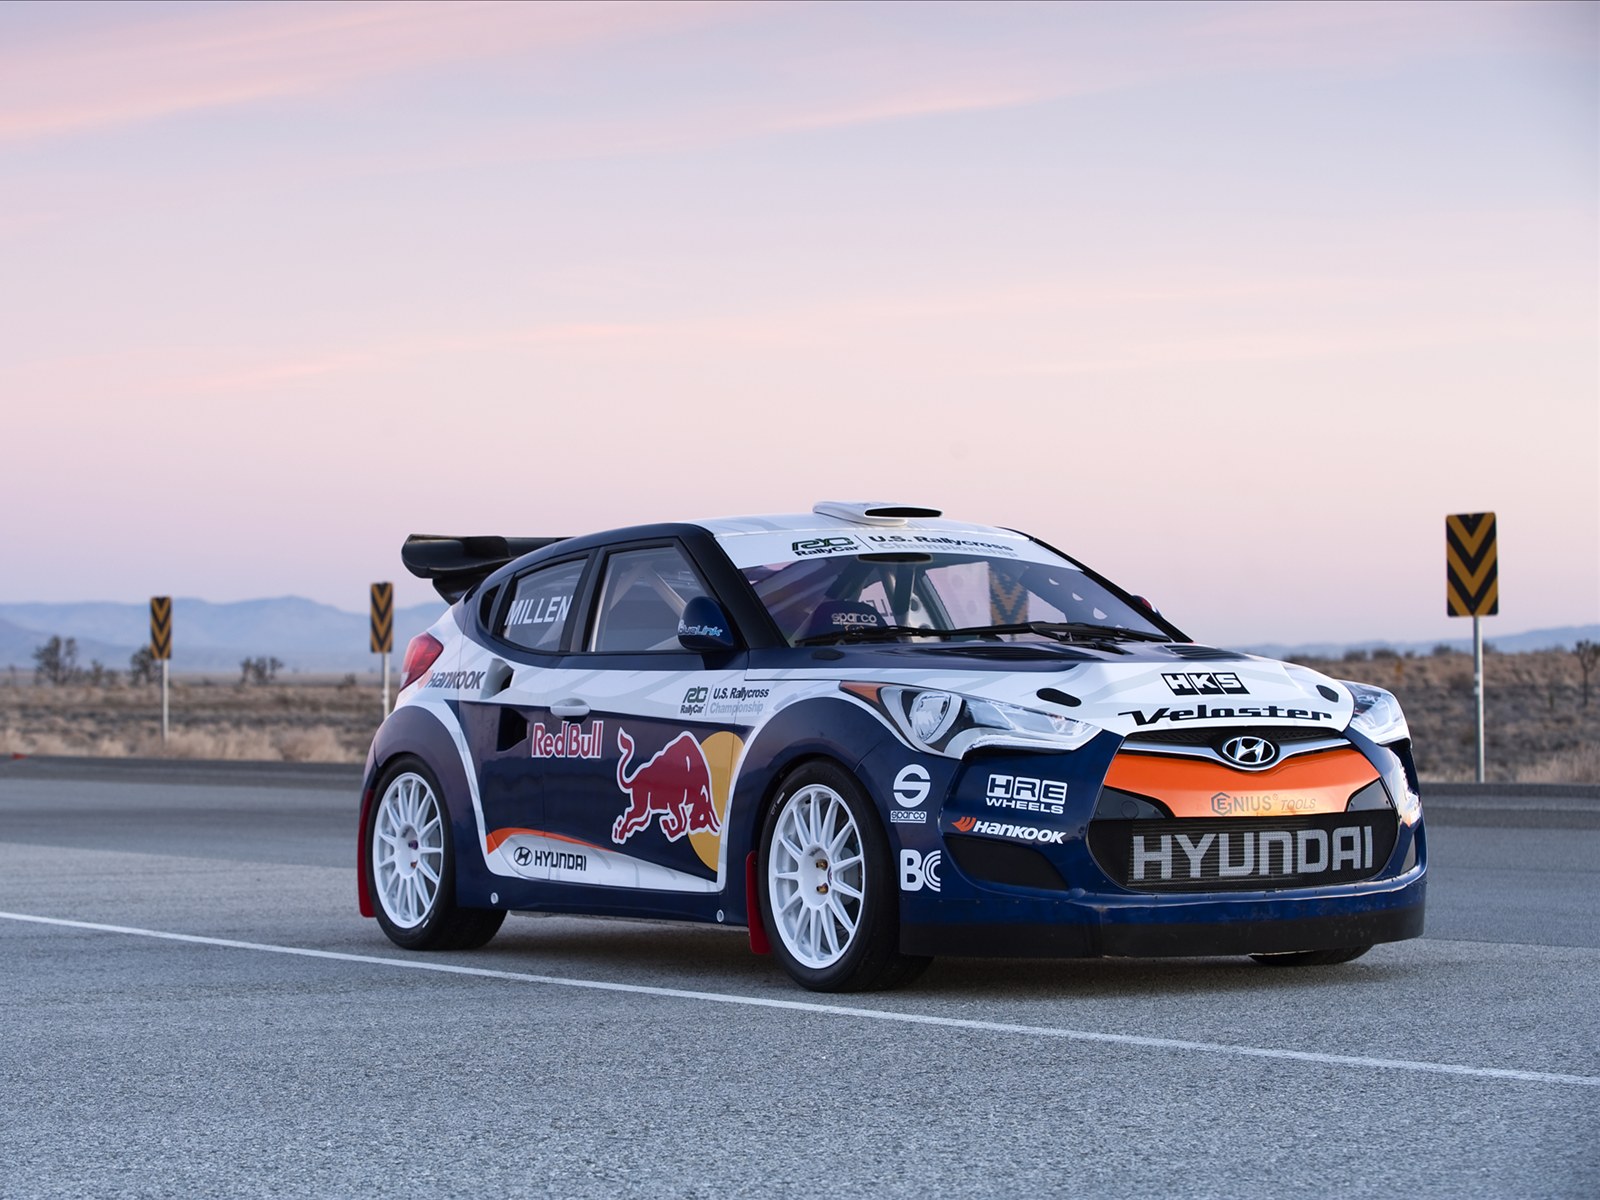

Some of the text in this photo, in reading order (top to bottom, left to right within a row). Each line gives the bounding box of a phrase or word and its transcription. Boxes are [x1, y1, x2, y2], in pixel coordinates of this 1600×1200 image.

[878, 543, 1018, 558] Championship
[914, 536, 1014, 551] Rallycross
[795, 546, 859, 557] RallyCar
[504, 595, 573, 626] MILLEN
[831, 612, 877, 624] sparco
[1162, 673, 1248, 694] HKS
[713, 686, 770, 701] U.S. Rallycross
[680, 703, 705, 716] RallyCar
[709, 701, 764, 715] Championship
[1118, 704, 1332, 726] Veloster
[531, 720, 604, 759] Red Bull
[986, 773, 1068, 805] HRE
[986, 797, 1064, 814] WHEELS
[1280, 798, 1317, 811] TOOLS
[891, 811, 926, 823] sparco
[1133, 825, 1373, 880] HYUNDAI
[534, 849, 587, 872] HYUNDAI
